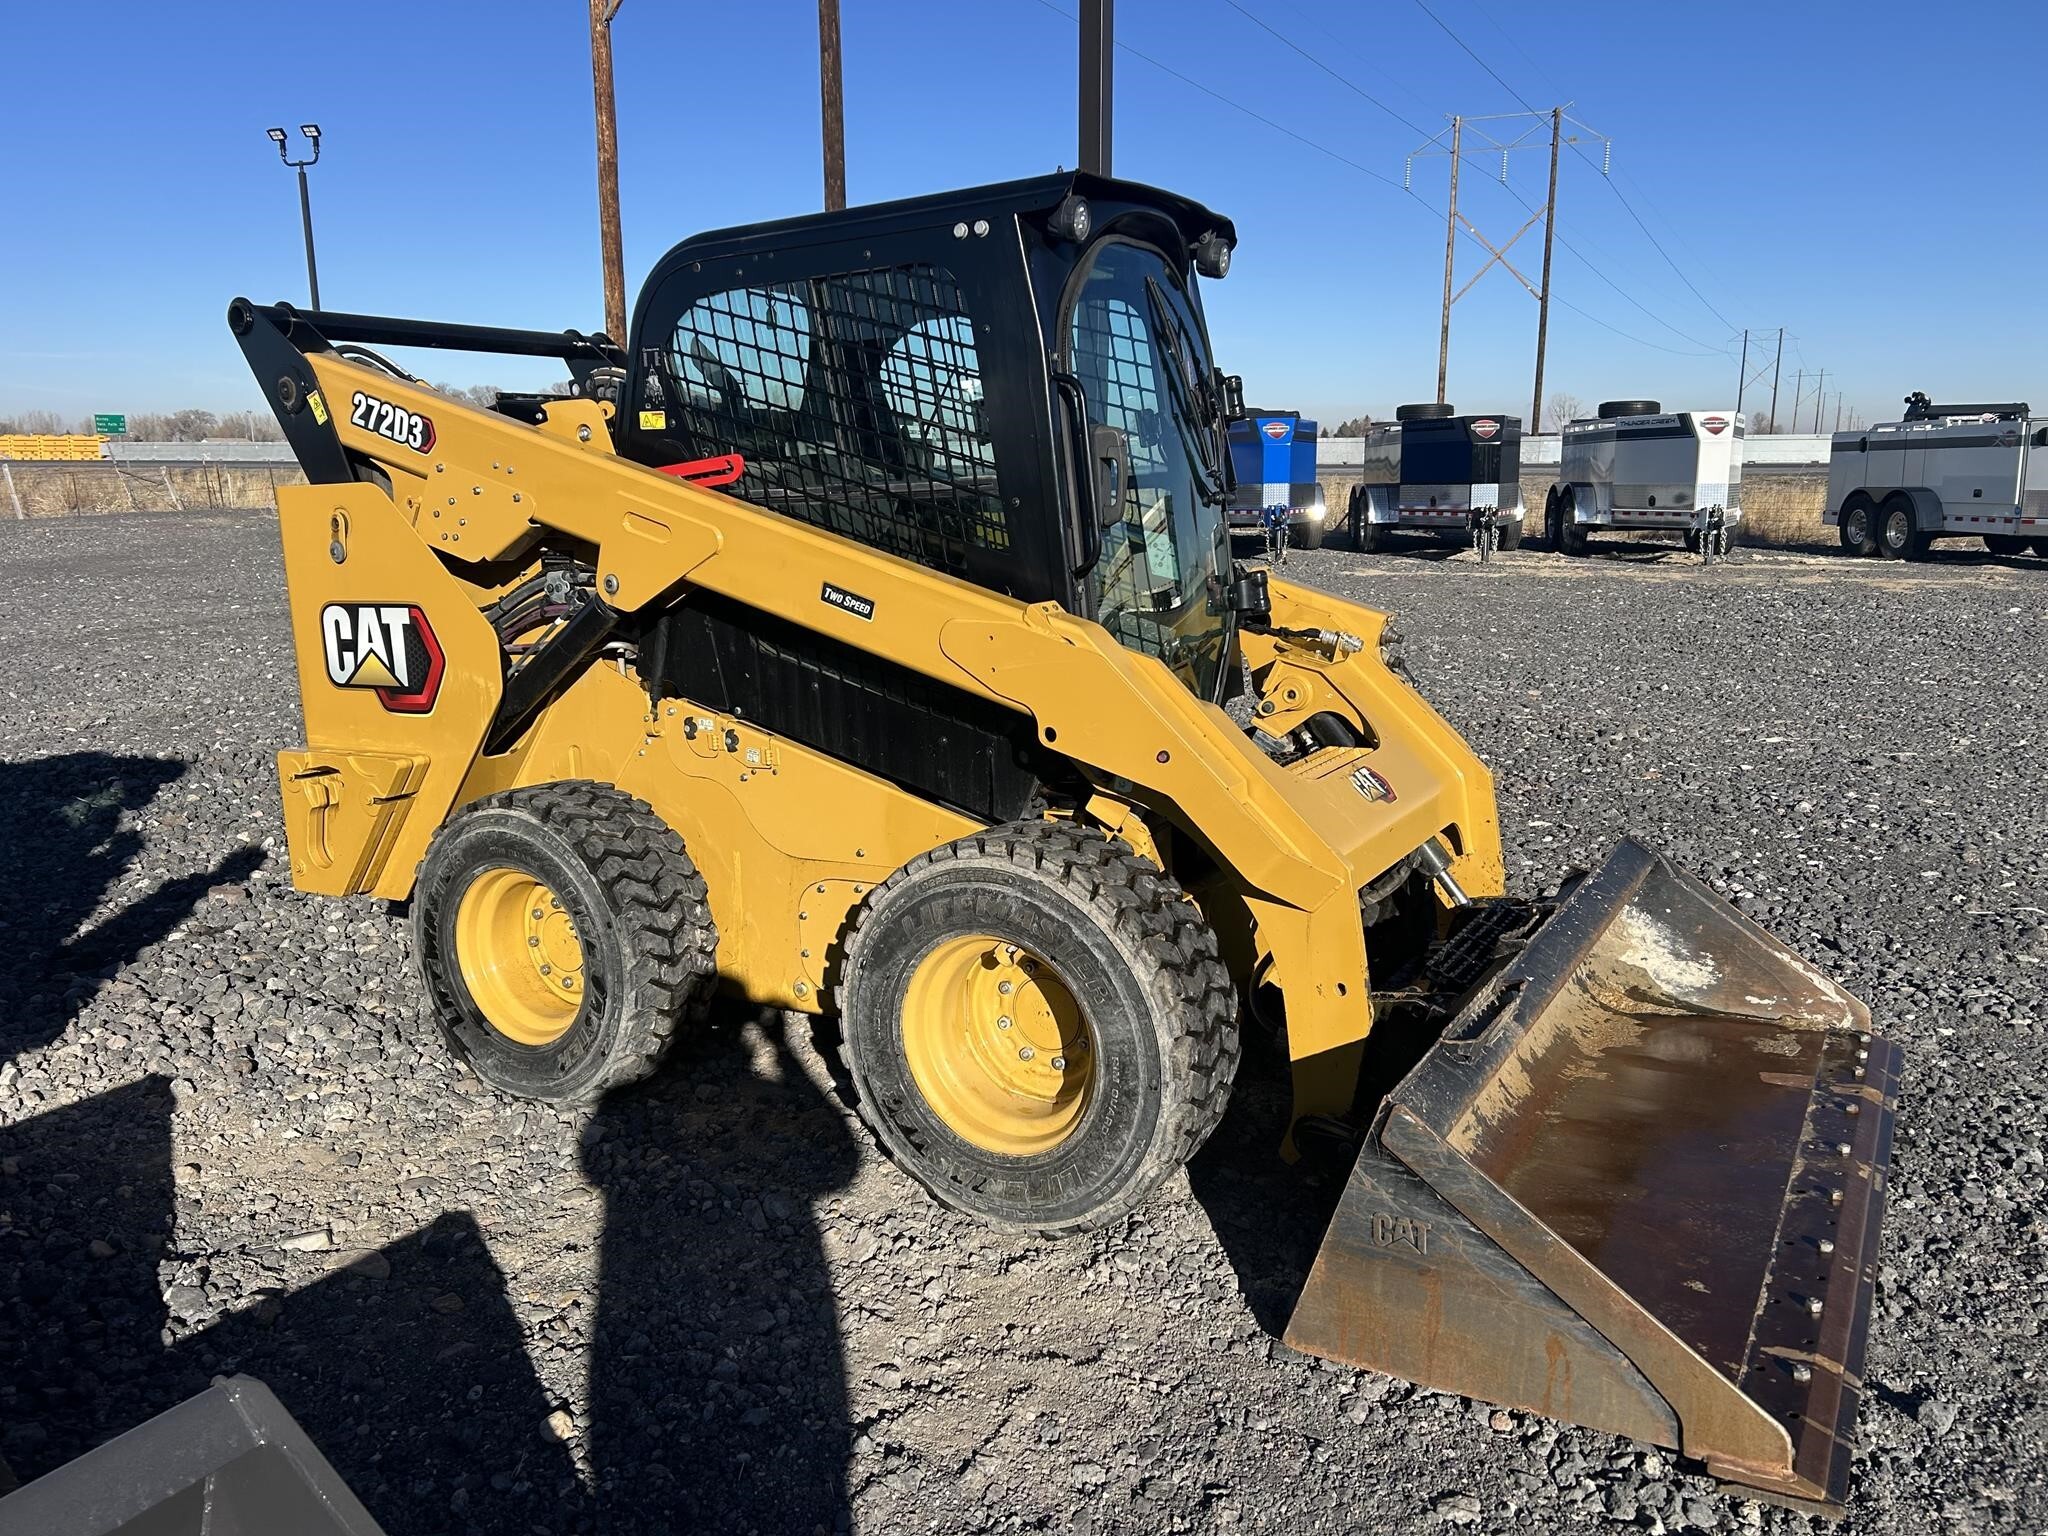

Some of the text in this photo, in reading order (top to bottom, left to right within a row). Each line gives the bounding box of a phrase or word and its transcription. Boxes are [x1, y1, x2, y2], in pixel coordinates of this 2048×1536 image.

[351, 391, 424, 449] 272D3
[322, 604, 411, 688] CAT
[1349, 766, 1388, 802] CAT
[1371, 1211, 1432, 1255] CAT
